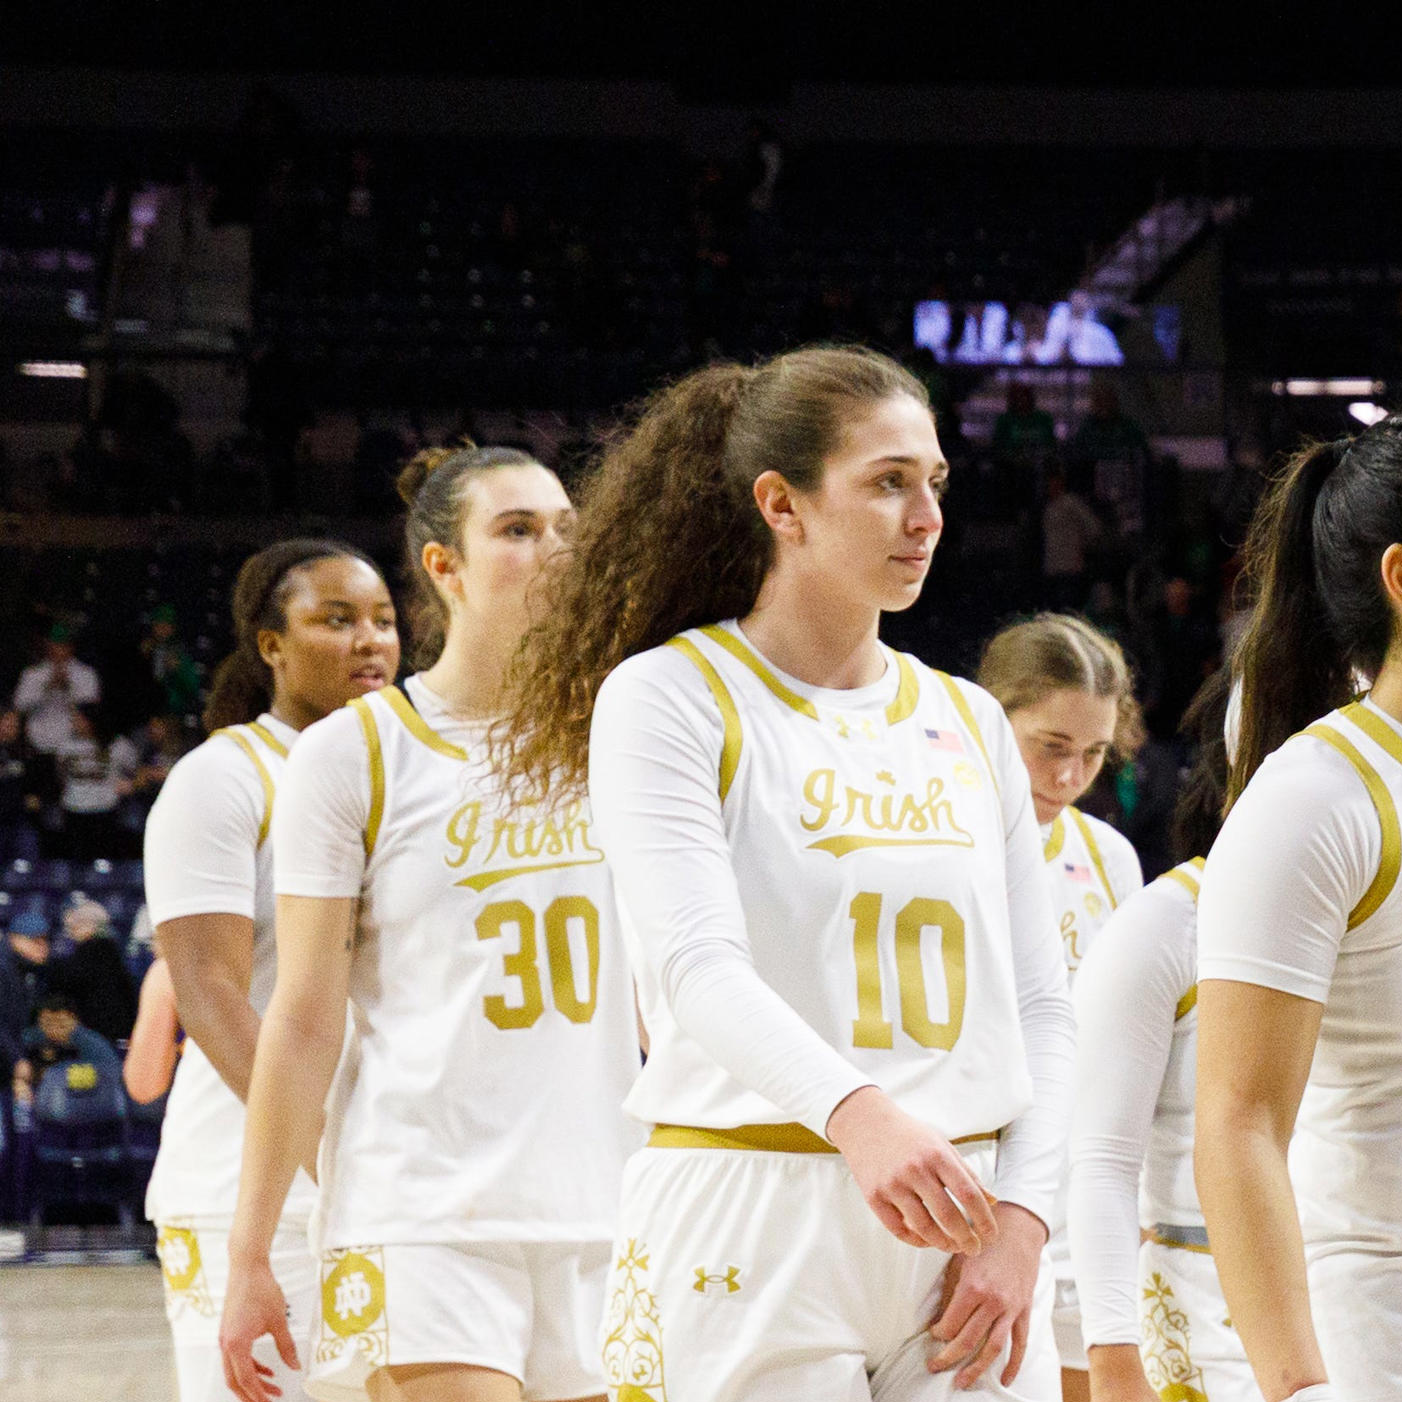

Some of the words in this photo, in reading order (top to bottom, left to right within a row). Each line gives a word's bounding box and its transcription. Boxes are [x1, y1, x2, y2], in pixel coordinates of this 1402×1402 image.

[445, 796, 605, 866] Irish
[799, 767, 975, 848] Irish
[474, 895, 600, 1031] 30
[849, 890, 967, 1052] 10
